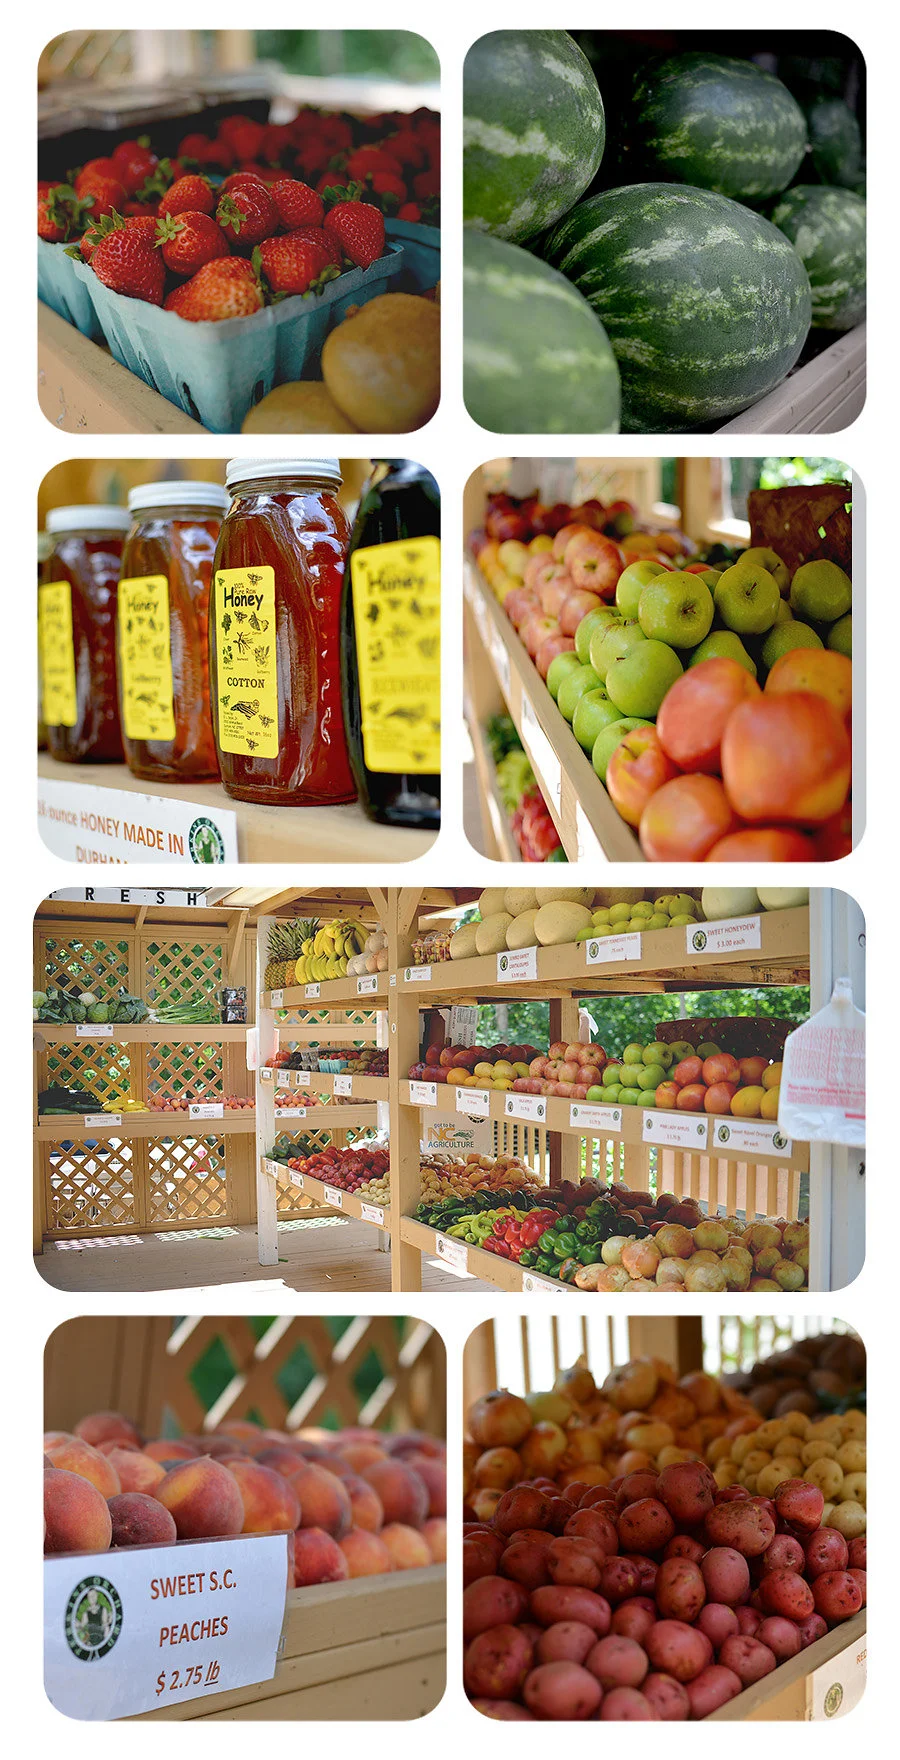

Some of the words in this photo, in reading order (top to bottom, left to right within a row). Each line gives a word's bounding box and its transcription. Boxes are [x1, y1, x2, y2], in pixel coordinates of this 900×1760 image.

[224, 587, 264, 611] Honey
[227, 677, 265, 689] COTTON
[80, 809, 120, 839] HONEY
[123, 822, 165, 851] MADE
[168, 833, 185, 856] IN
[75, 845, 129, 864] DURH
[707, 928, 724, 937] SWEET
[725, 922, 756, 934] HONEYDEW
[428, 1127, 455, 1141] NC
[150, 1572, 206, 1600] SWEET
[209, 1568, 237, 1592] S.C.
[159, 1615, 229, 1648] PEACHES
[155, 1670, 166, 1697] $
[169, 1664, 203, 1691] 2.75
[203, 1660, 221, 1687] lb
